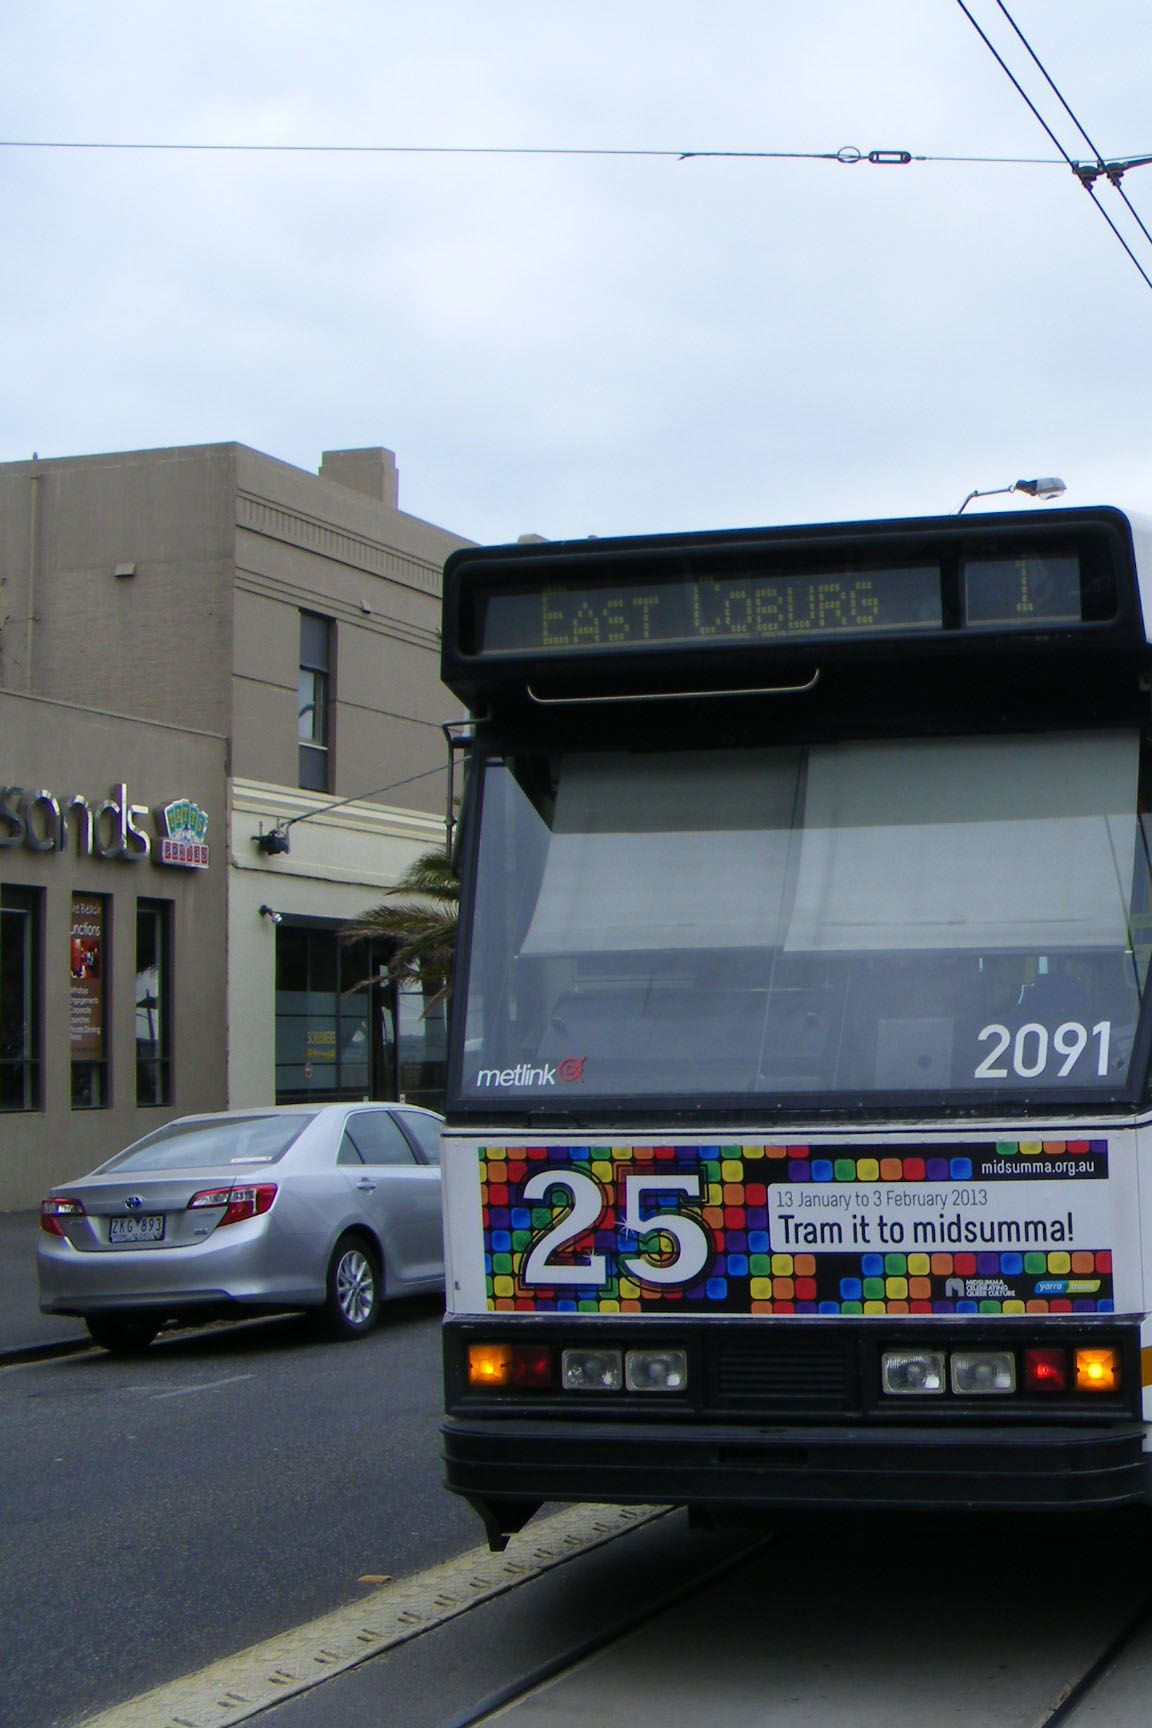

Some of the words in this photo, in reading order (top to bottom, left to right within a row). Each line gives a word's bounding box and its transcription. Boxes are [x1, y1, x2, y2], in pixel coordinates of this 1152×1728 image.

[542, 586, 660, 646] EAST
[974, 1021, 1113, 1079] 2091
[476, 1063, 557, 1087] metlink
[981, 1159, 1096, 1176] midsumma.org.au
[776, 1191, 793, 1208] 13
[798, 1191, 852, 1211] January
[855, 1192, 870, 1208] to
[872, 1190, 883, 1207] 3
[886, 1190, 948, 1210] February
[951, 1189, 988, 1207] 2013
[141, 1218, 162, 1232] 893
[522, 1169, 710, 1285] 25
[778, 1214, 843, 1245] Tram
[851, 1213, 871, 1244] it
[878, 1213, 906, 1244] to
[912, 1211, 1075, 1244] midsumma!
[1039, 1282, 1064, 1292] yarra
